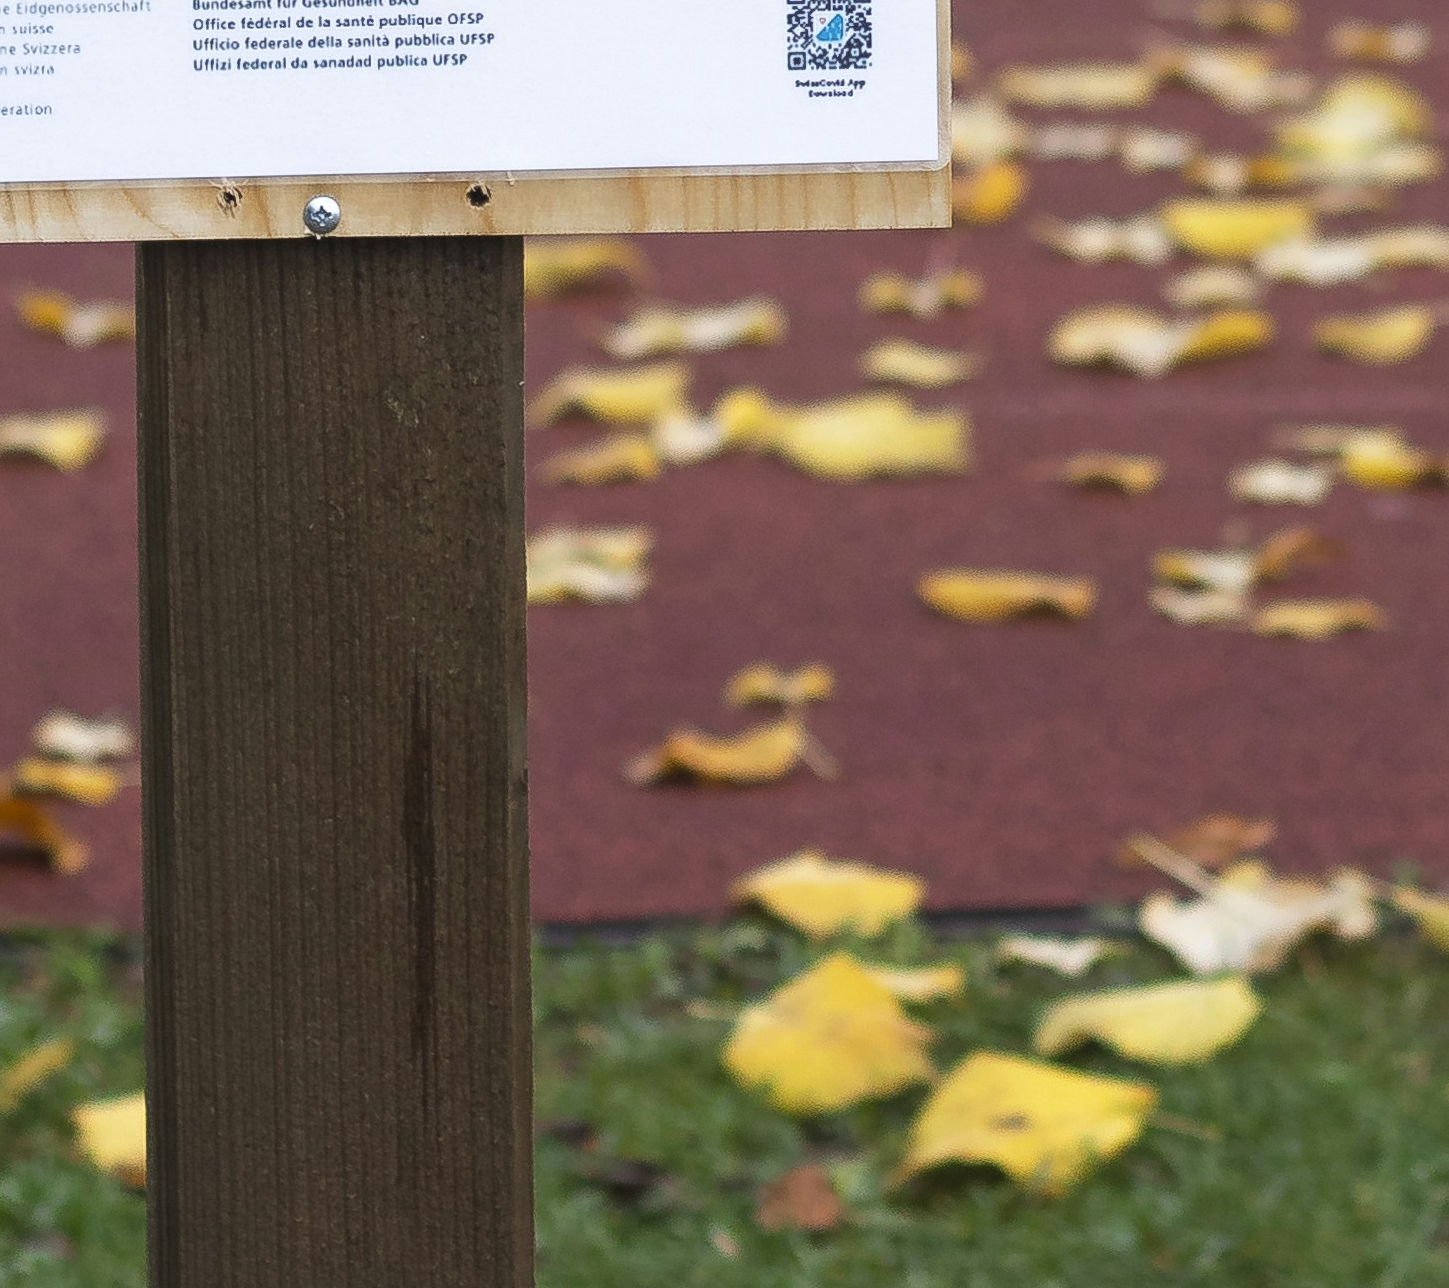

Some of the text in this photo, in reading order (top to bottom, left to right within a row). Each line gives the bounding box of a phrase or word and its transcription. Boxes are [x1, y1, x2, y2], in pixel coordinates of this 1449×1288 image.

[16, 0, 152, 18] Eidgenossenschaft
[193, 17, 236, 31] Office
[295, 16, 314, 29] de
[318, 15, 331, 28] la
[379, 13, 443, 29] publique
[447, 12, 484, 25] OFSP
[192, 37, 240, 51] Ufficio
[245, 36, 303, 50] federale
[307, 35, 342, 49] della
[394, 32, 455, 49] pubblica
[459, 32, 495, 46] UFSP
[193, 53, 468, 72] Uffizi federal da sanadad publica UFSP
